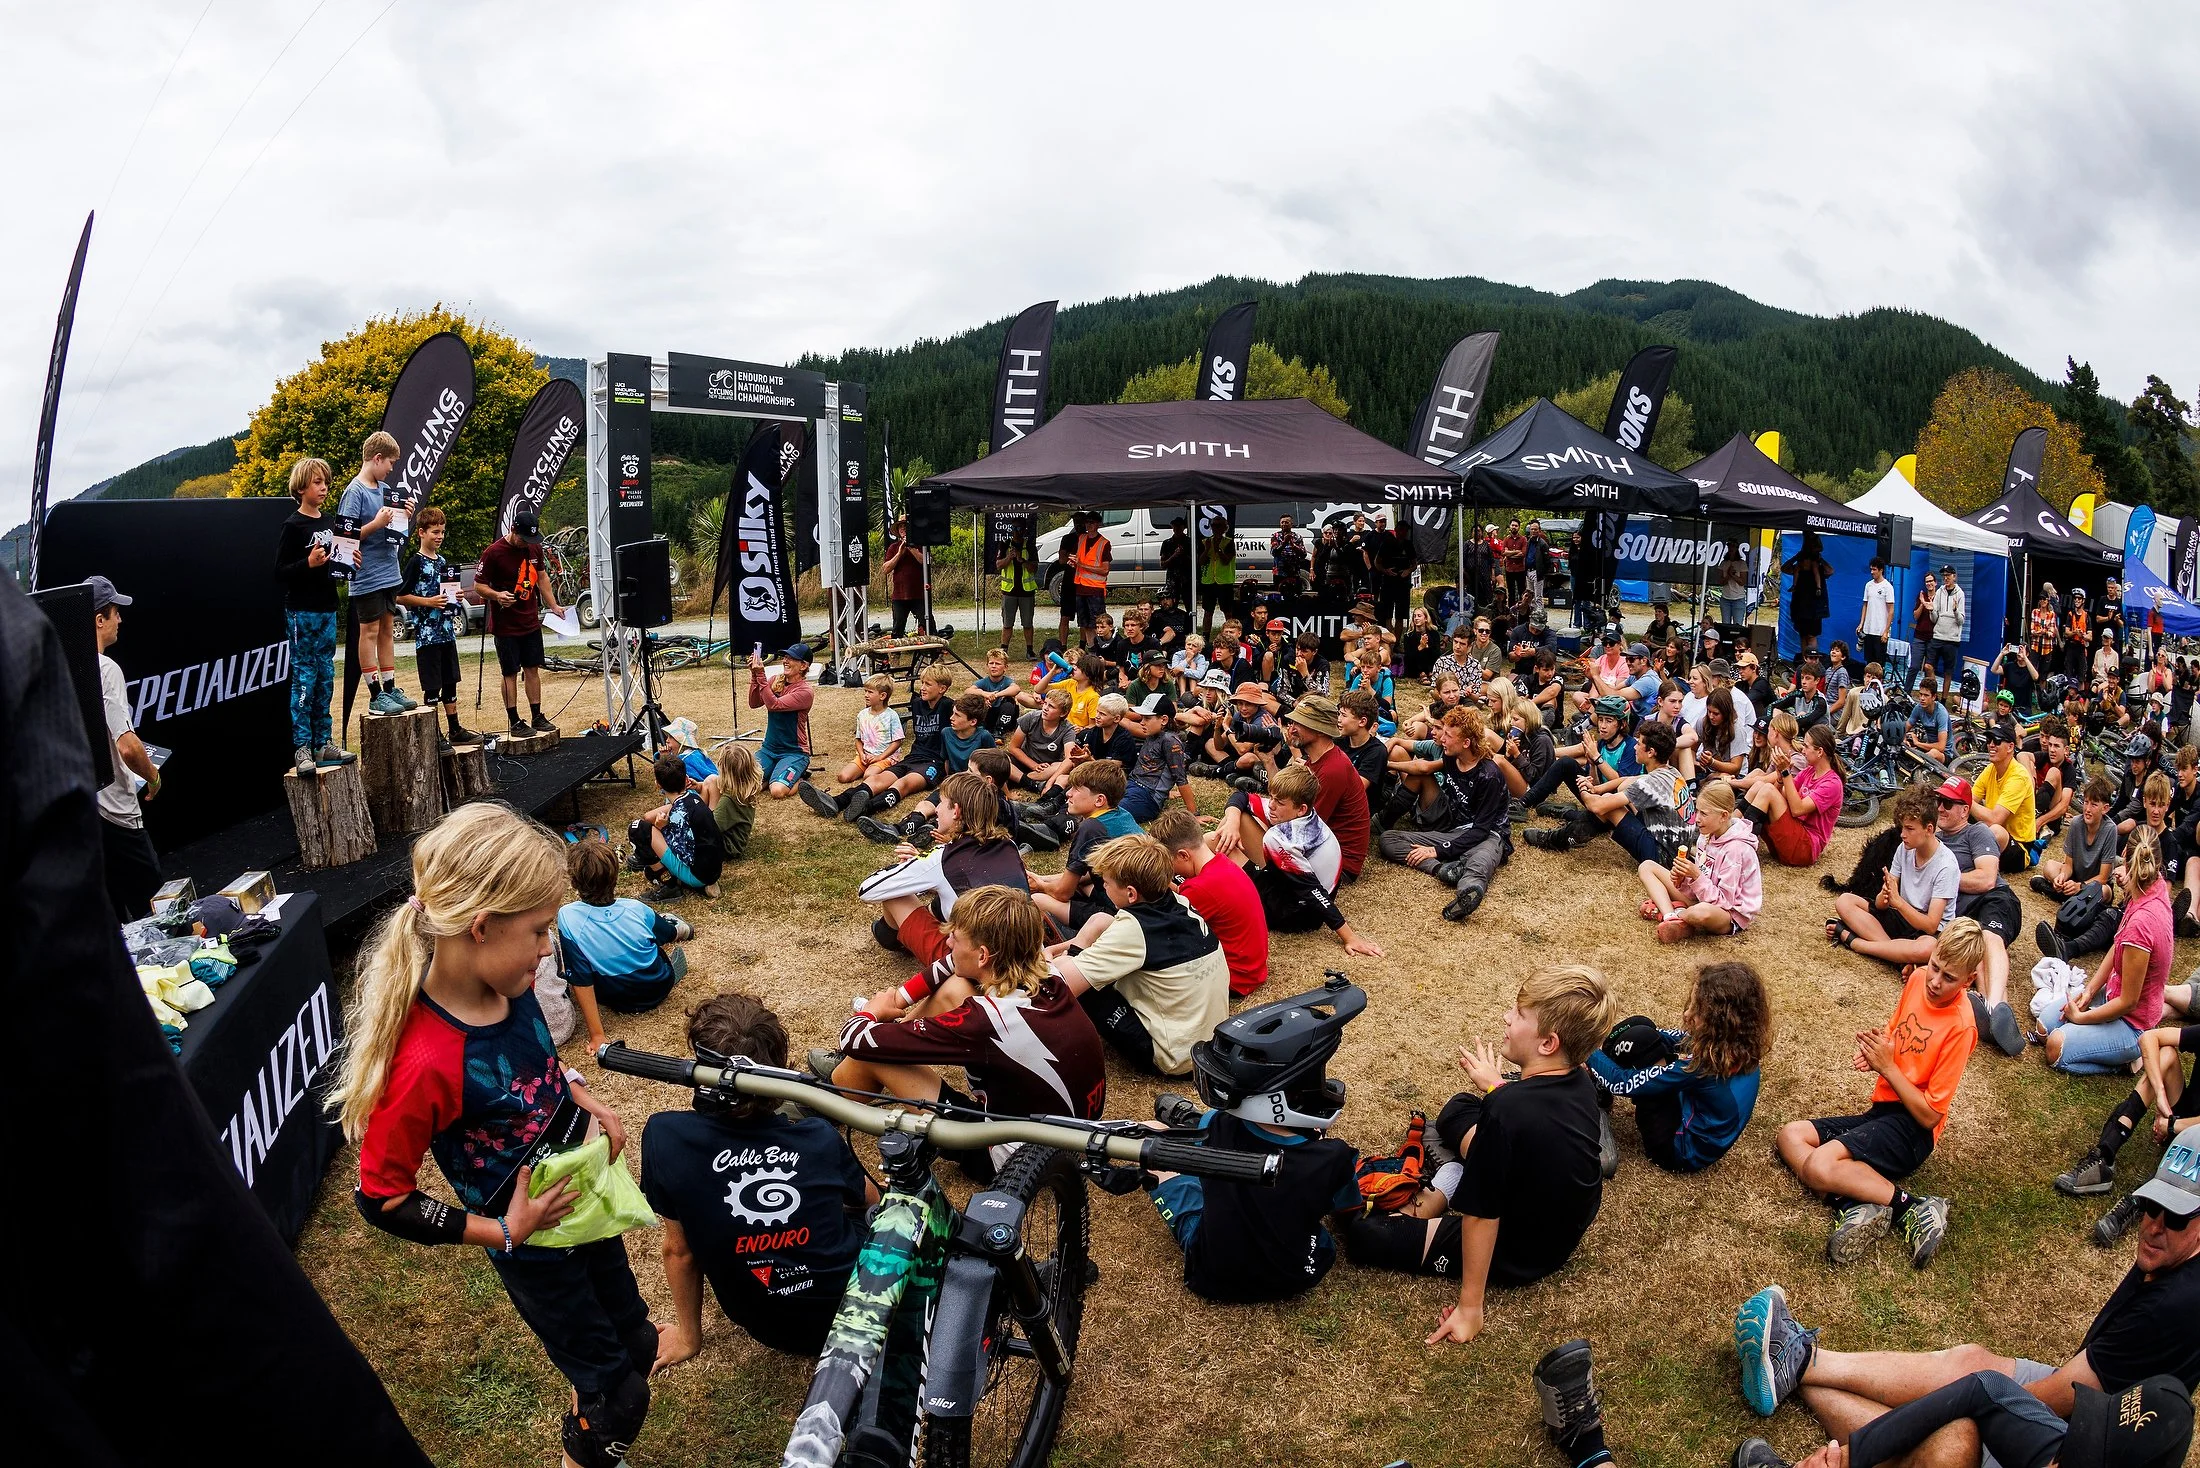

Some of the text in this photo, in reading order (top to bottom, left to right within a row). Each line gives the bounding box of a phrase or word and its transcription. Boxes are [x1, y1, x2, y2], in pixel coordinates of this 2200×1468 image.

[737, 382, 774, 395] NATIONAL
[738, 372, 784, 386] ENDURO MTB
[708, 388, 734, 397] CYCLING
[737, 392, 796, 407] CHAMPIONSHIPS
[1001, 349, 1042, 449] MITH
[397, 387, 460, 494] YCLING
[420, 401, 466, 483] ZEALAND
[1127, 441, 1251, 459] SMITH
[523, 415, 574, 499] CYCLING
[532, 424, 580, 508] NEW ZEALAND
[1520, 446, 1635, 476] SMITH
[1384, 484, 1453, 501] SMITH
[1573, 483, 1620, 500] SMITH
[1737, 481, 1819, 505] SOUNDBOKS
[738, 470, 772, 574] Silky
[767, 503, 776, 527] saws
[1806, 515, 1877, 535] BREAK THROUGH THE NOISE
[769, 527, 777, 550] hand
[1236, 541, 1267, 551] PARK
[771, 550, 780, 576] finest
[1235, 572, 1262, 580] park.com
[775, 576, 786, 607] world's
[1311, 888, 1331, 909] THOR
[221, 981, 333, 1189] IALIZED
[1610, 1082, 1625, 1095] LEE
[1625, 1062, 1676, 1094] DESIGNS
[1268, 1093, 1285, 1124] poc
[528, 1156, 540, 1169] able
[712, 1145, 801, 1173] Cable Bay
[1154, 1196, 1175, 1228] FO
[1079, 1205, 1088, 1249] BUTCHER
[735, 1226, 810, 1255] ENDURO
